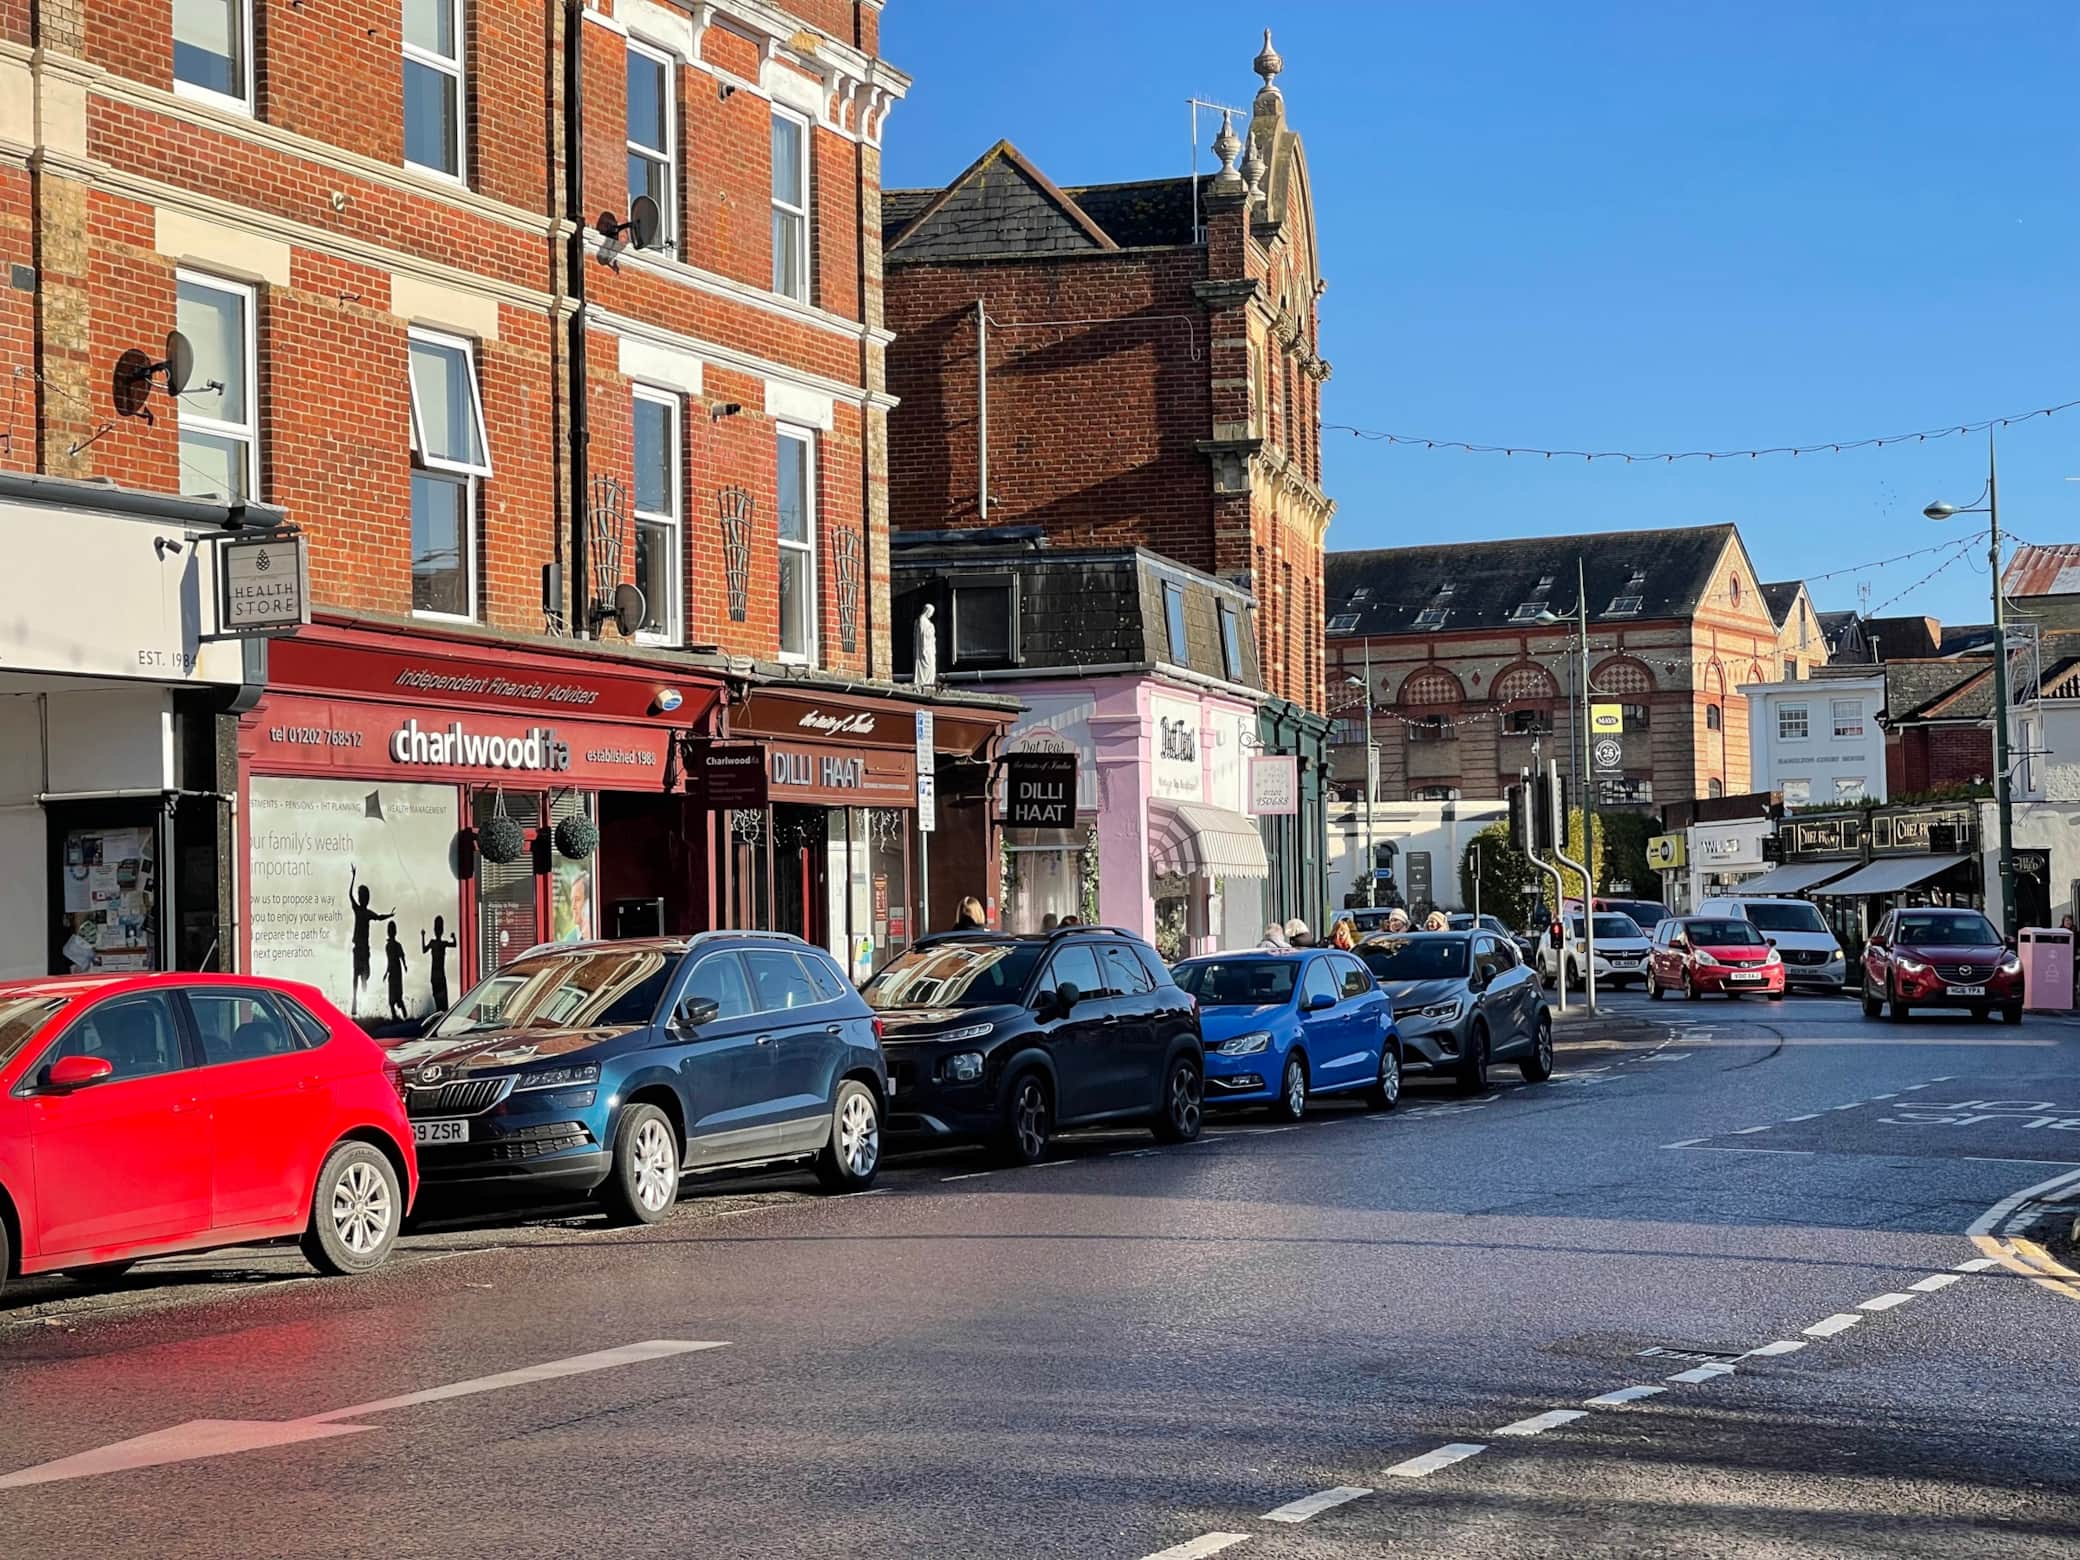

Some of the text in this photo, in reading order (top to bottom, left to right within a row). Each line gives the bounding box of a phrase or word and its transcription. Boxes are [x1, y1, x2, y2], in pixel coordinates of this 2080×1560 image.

[235, 584, 293, 598] HEALTH
[235, 598, 293, 615] STORE
[138, 650, 165, 667] EST.
[397, 668, 600, 705] Independent Financial Advisers
[270, 726, 363, 747] tel 01202 768512
[1043, 739, 1065, 753] Teas
[586, 747, 636, 764] established
[773, 752, 865, 789] DILLI HAAT
[1020, 782, 1063, 799] DILLI
[1016, 804, 1067, 821] HAAT
[268, 829, 313, 856] family's
[315, 832, 354, 851] wealth
[273, 894, 281, 904] to
[282, 896, 313, 908] propose
[320, 896, 336, 906] way
[267, 912, 276, 922] to
[277, 911, 298, 924] enjoy
[300, 913, 319, 924] your
[319, 910, 343, 921] wealth
[255, 931, 285, 943] prepare
[286, 928, 299, 940] the
[301, 927, 319, 943] path
[253, 948, 271, 959] next
[431, 1123, 461, 1139] ZSR
